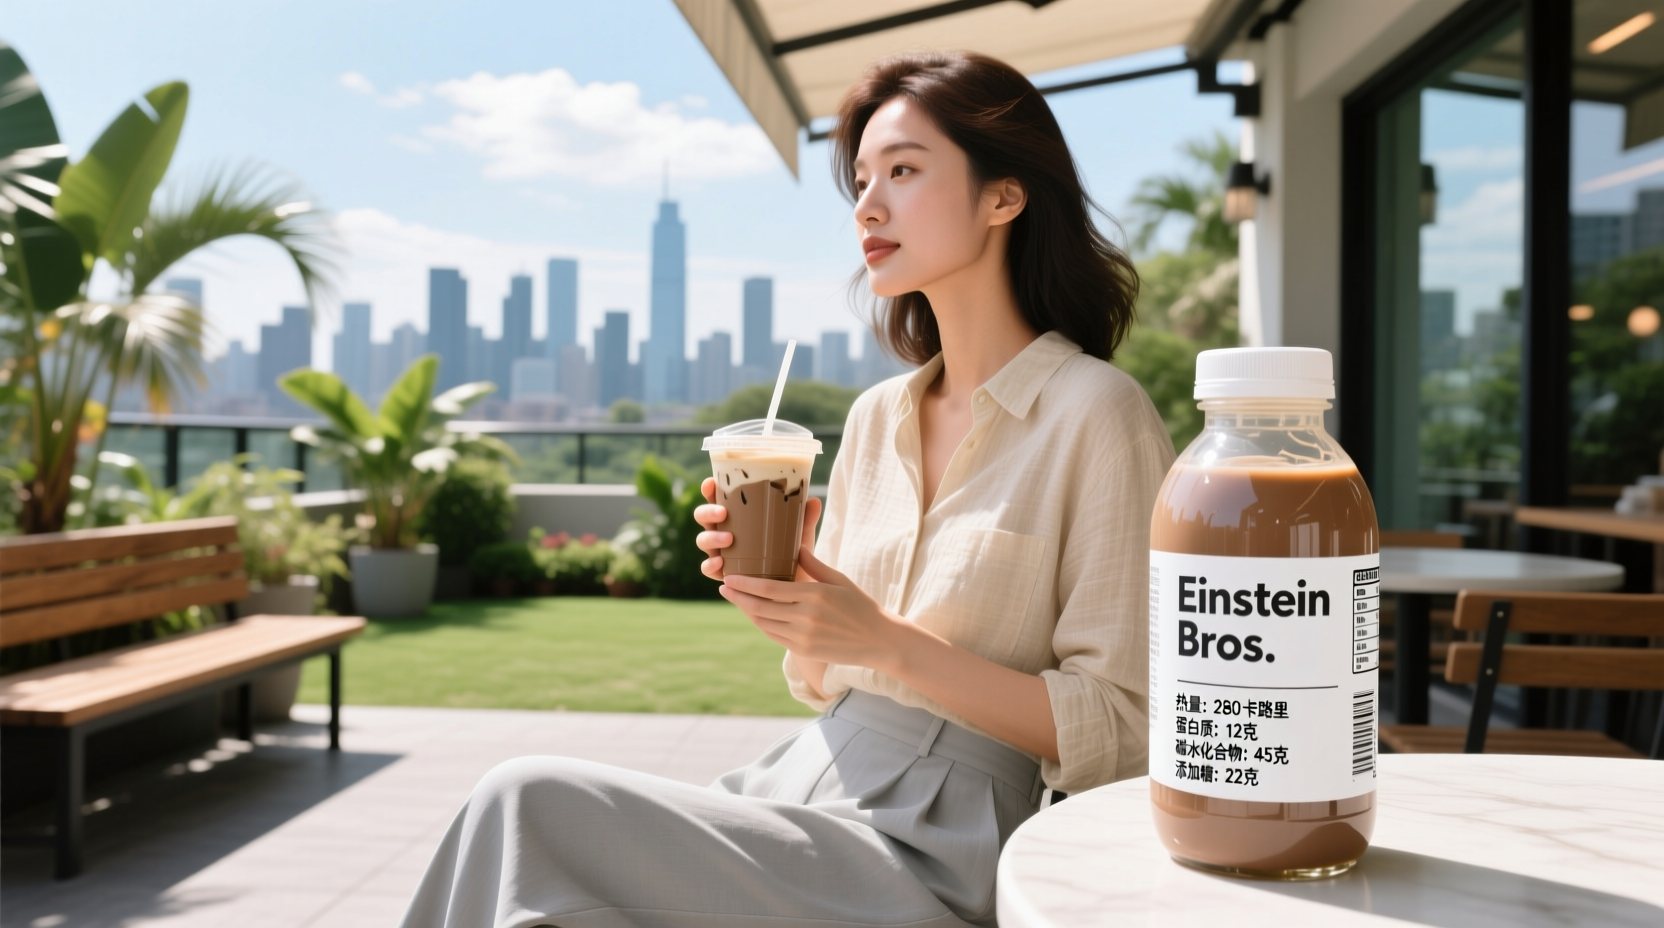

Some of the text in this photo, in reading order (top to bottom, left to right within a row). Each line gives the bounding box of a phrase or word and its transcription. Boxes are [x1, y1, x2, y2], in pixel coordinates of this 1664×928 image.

[1178, 575, 1330, 617] Einstein
[1178, 619, 1275, 663] Bros.
[1225, 721, 1258, 741] 12克
[1253, 744, 1290, 765] 45克
[1224, 766, 1259, 787] 22克
